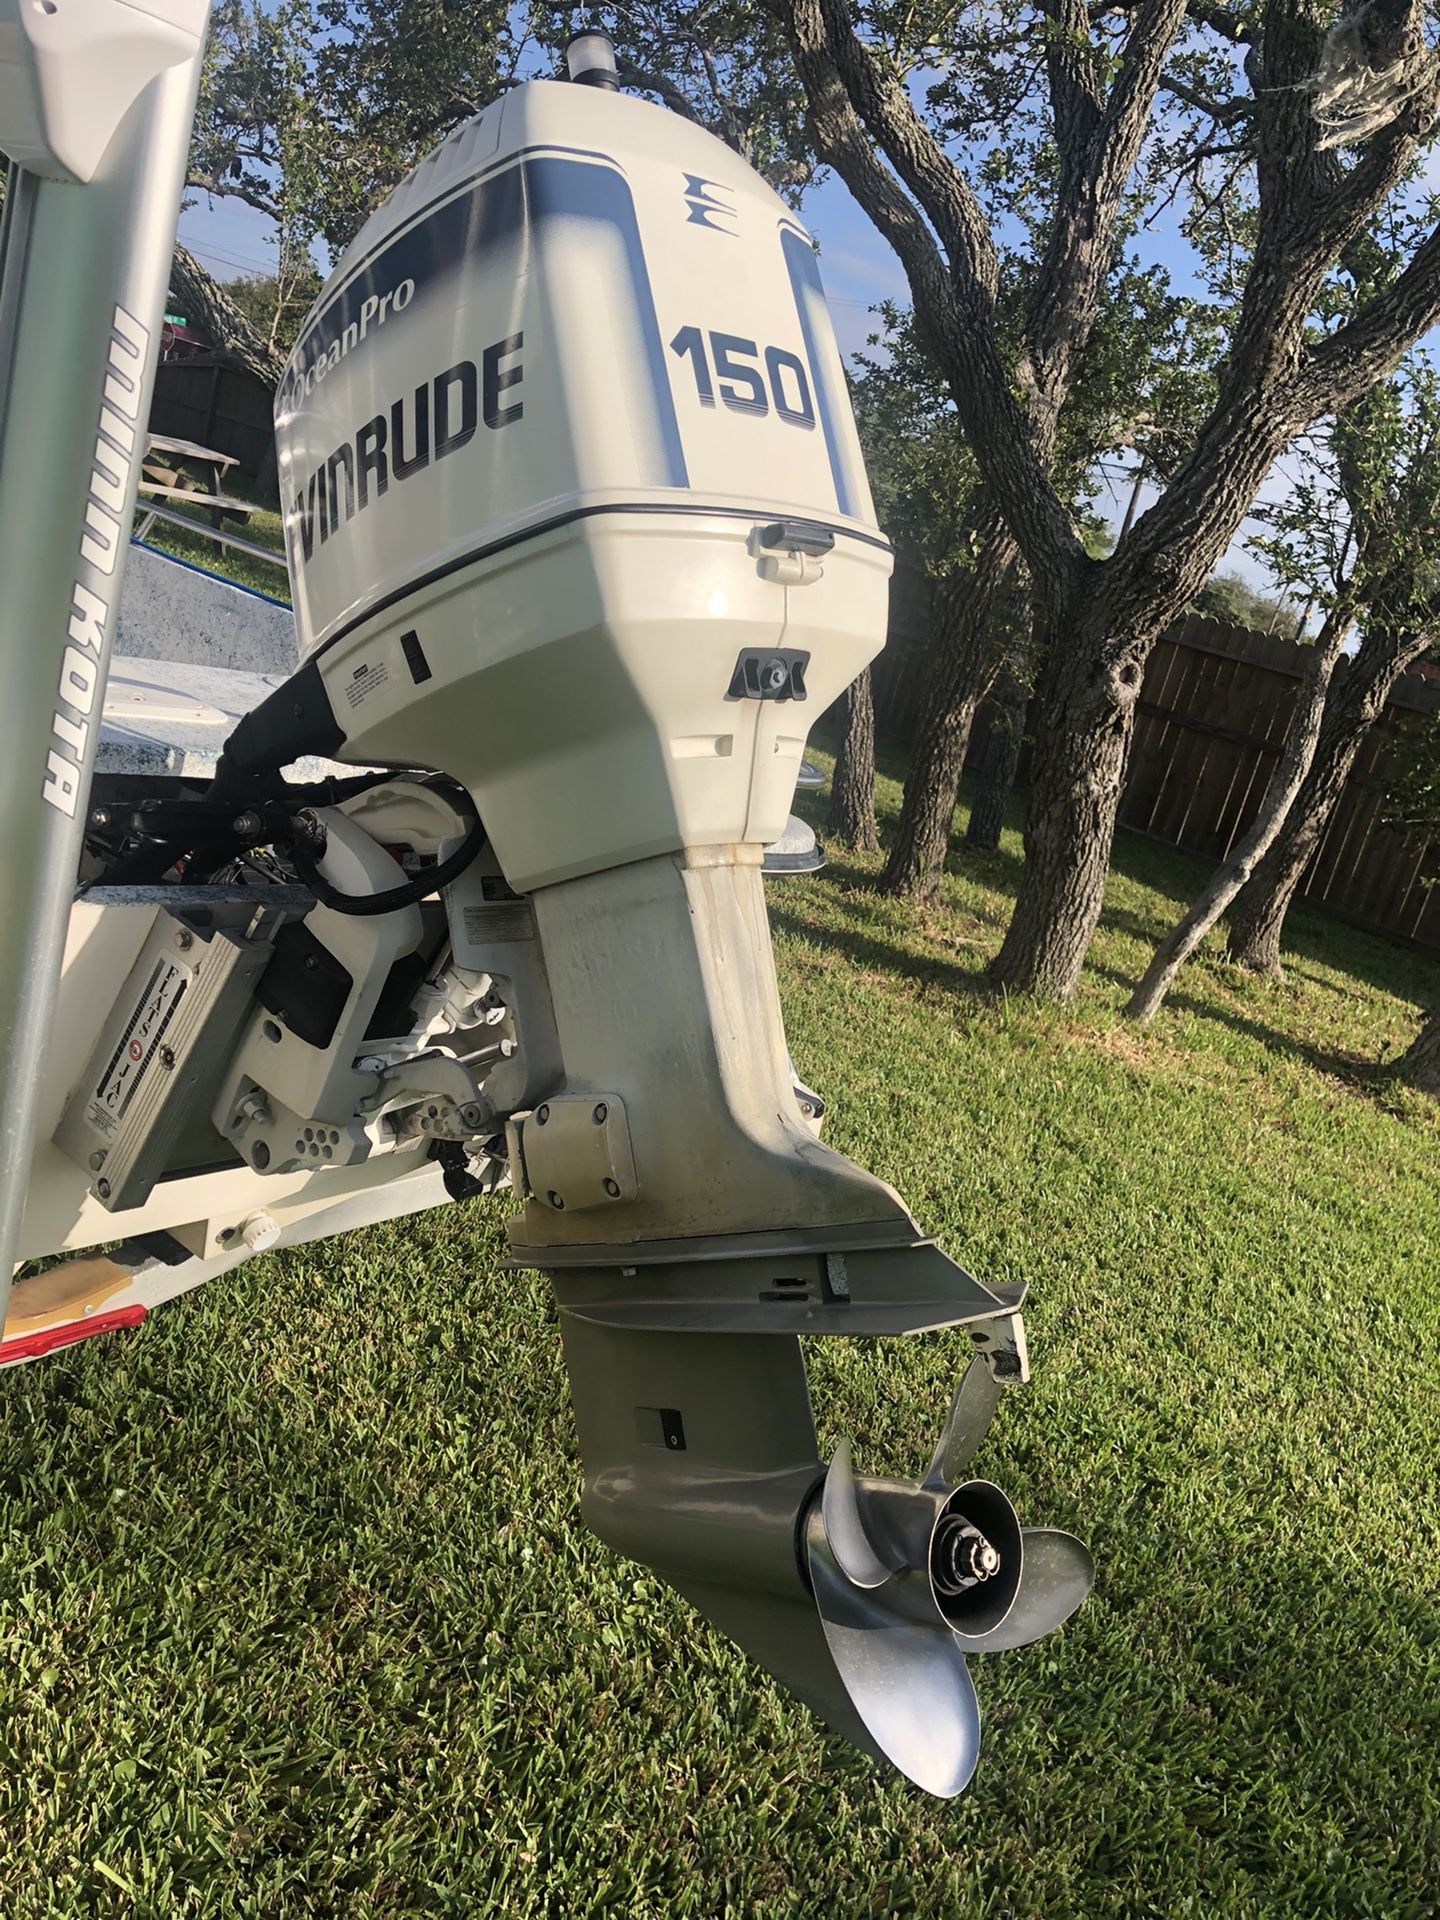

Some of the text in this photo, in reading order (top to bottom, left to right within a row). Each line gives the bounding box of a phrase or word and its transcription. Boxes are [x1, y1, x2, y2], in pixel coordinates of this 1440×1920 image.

[291, 278, 415, 411] OceanPro
[670, 326, 815, 431] 150
[289, 331, 524, 565] VINRUDE
[106, 966, 179, 1108] FLATS JAC
